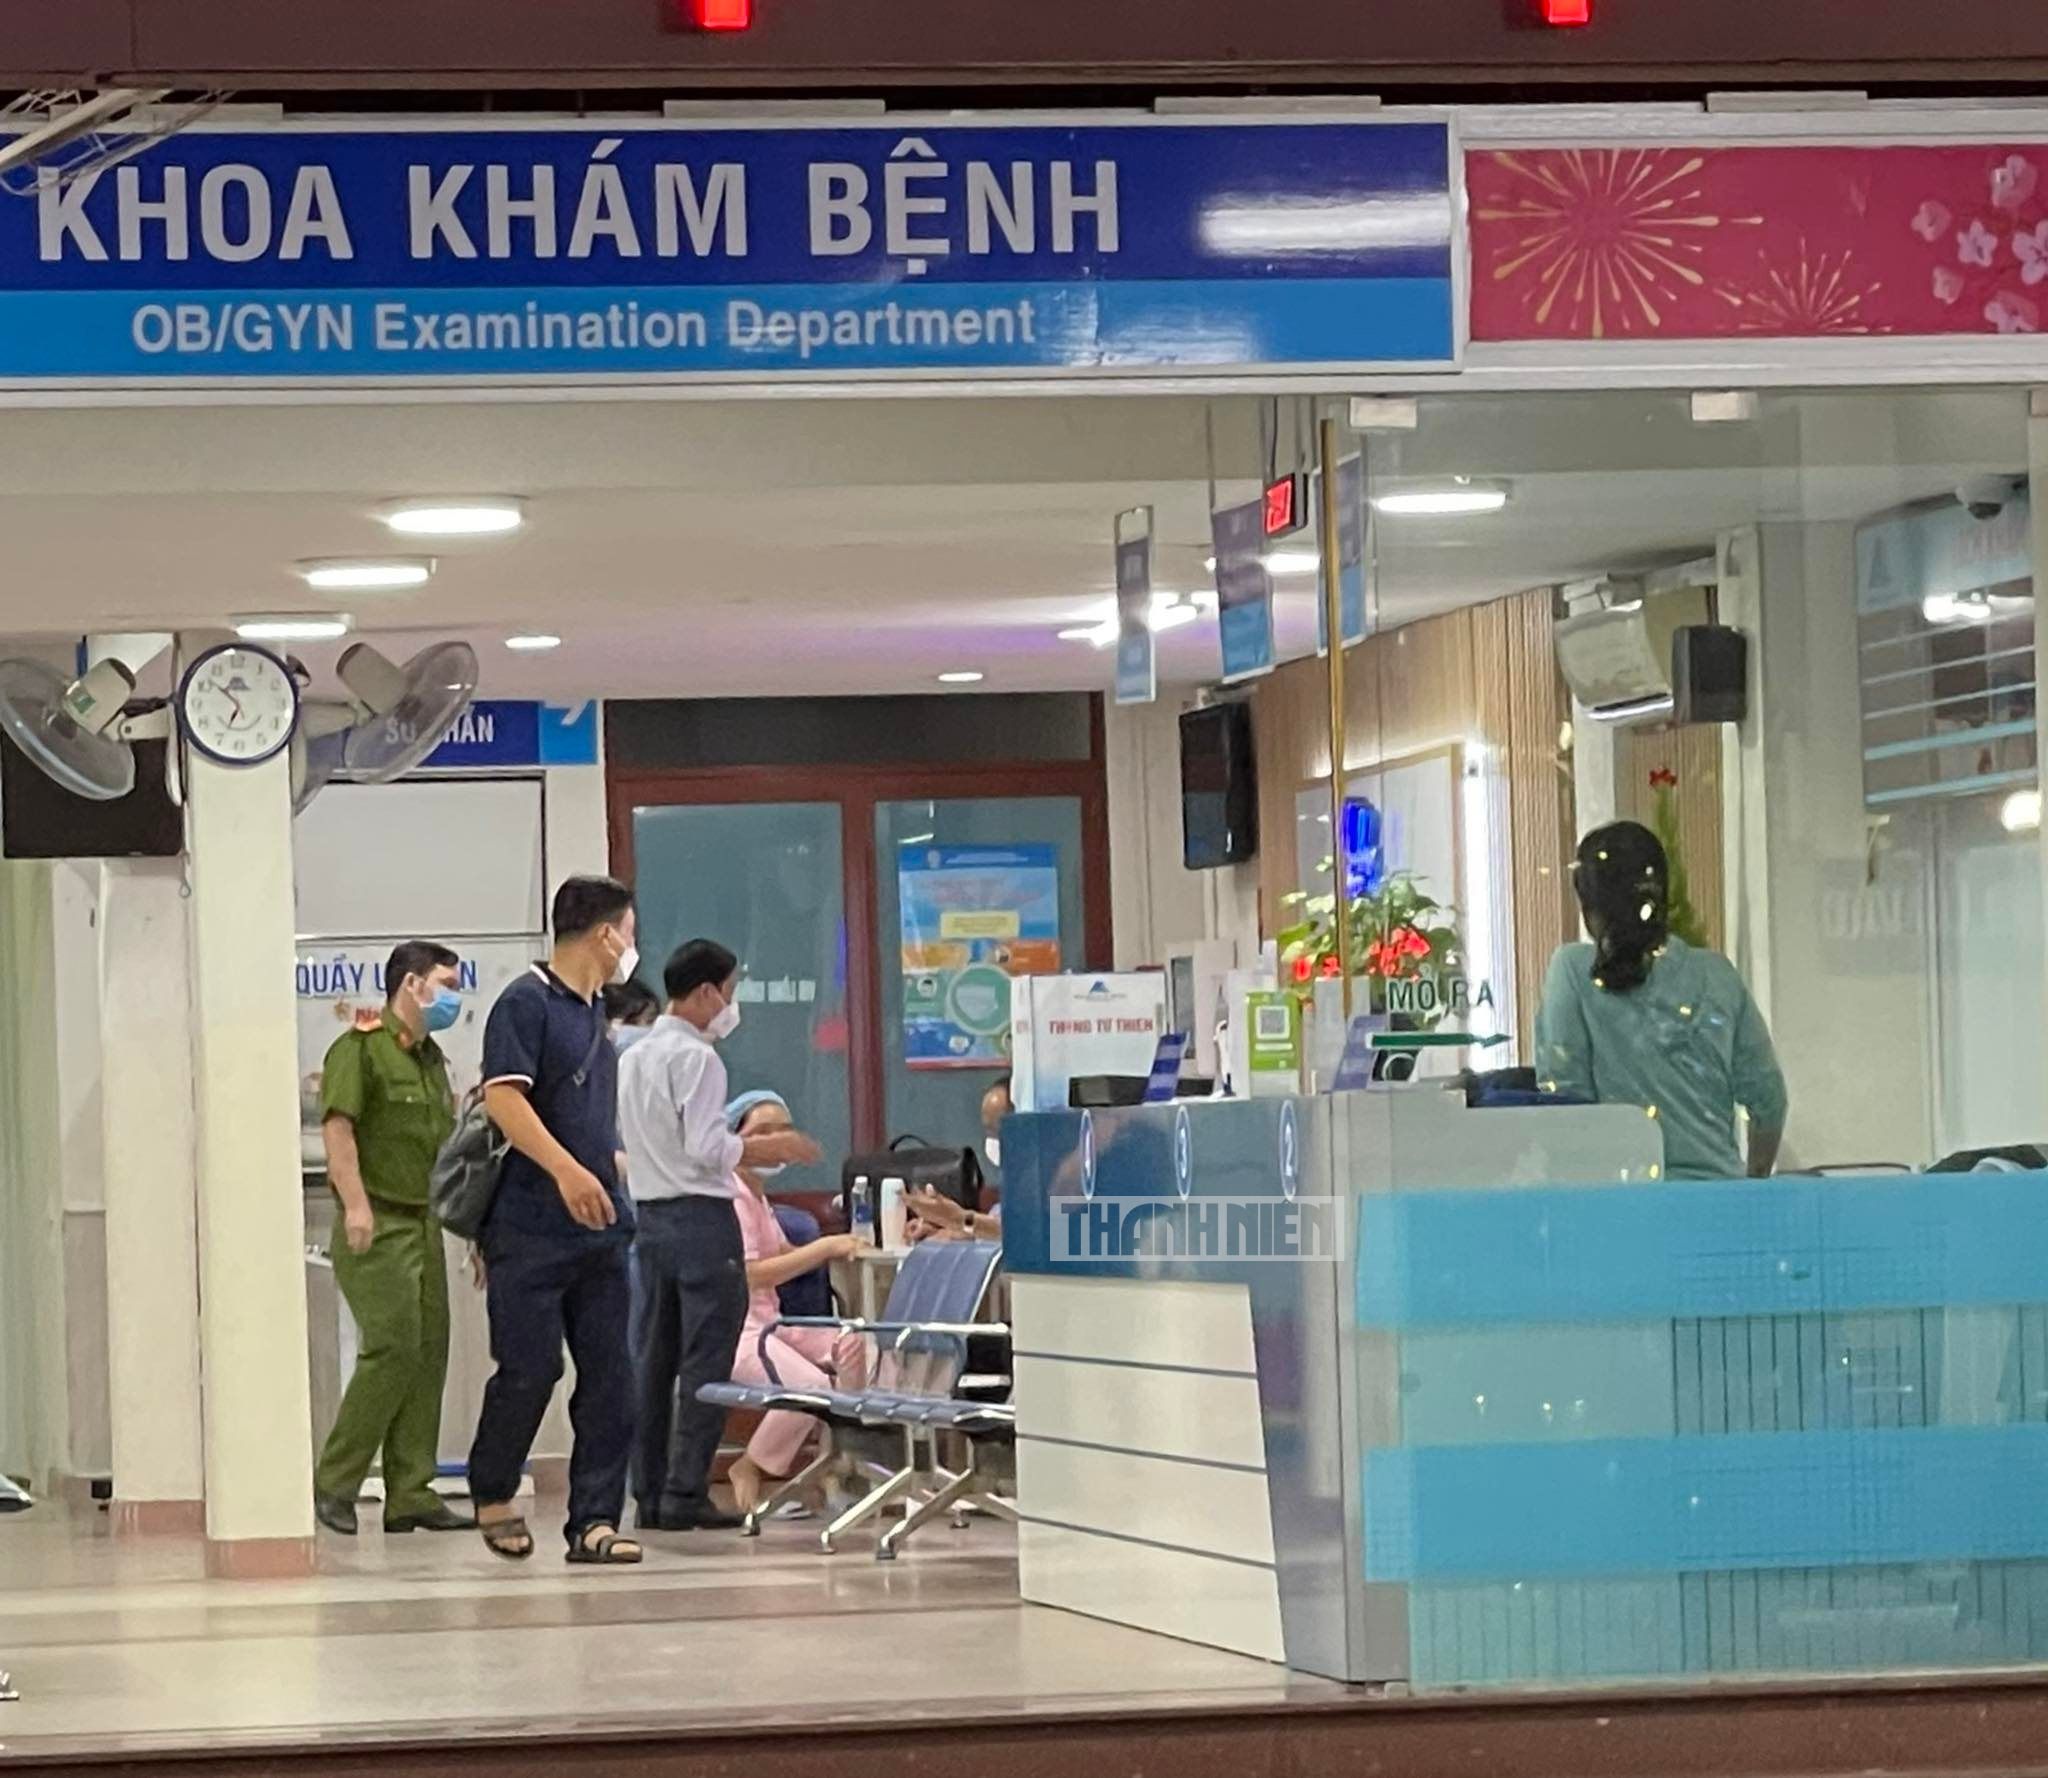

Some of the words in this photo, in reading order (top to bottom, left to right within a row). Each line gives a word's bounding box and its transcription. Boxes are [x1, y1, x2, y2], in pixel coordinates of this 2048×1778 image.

[37, 162, 354, 262] KHOA
[409, 138, 748, 259] KHÁM
[807, 136, 1119, 275] BỆNH
[131, 303, 353, 355] OB/GYN
[374, 301, 707, 352] Examination
[726, 299, 1036, 359] Department
[1451, 978, 1495, 1008] RA
[1282, 1120, 1296, 1179] 2
